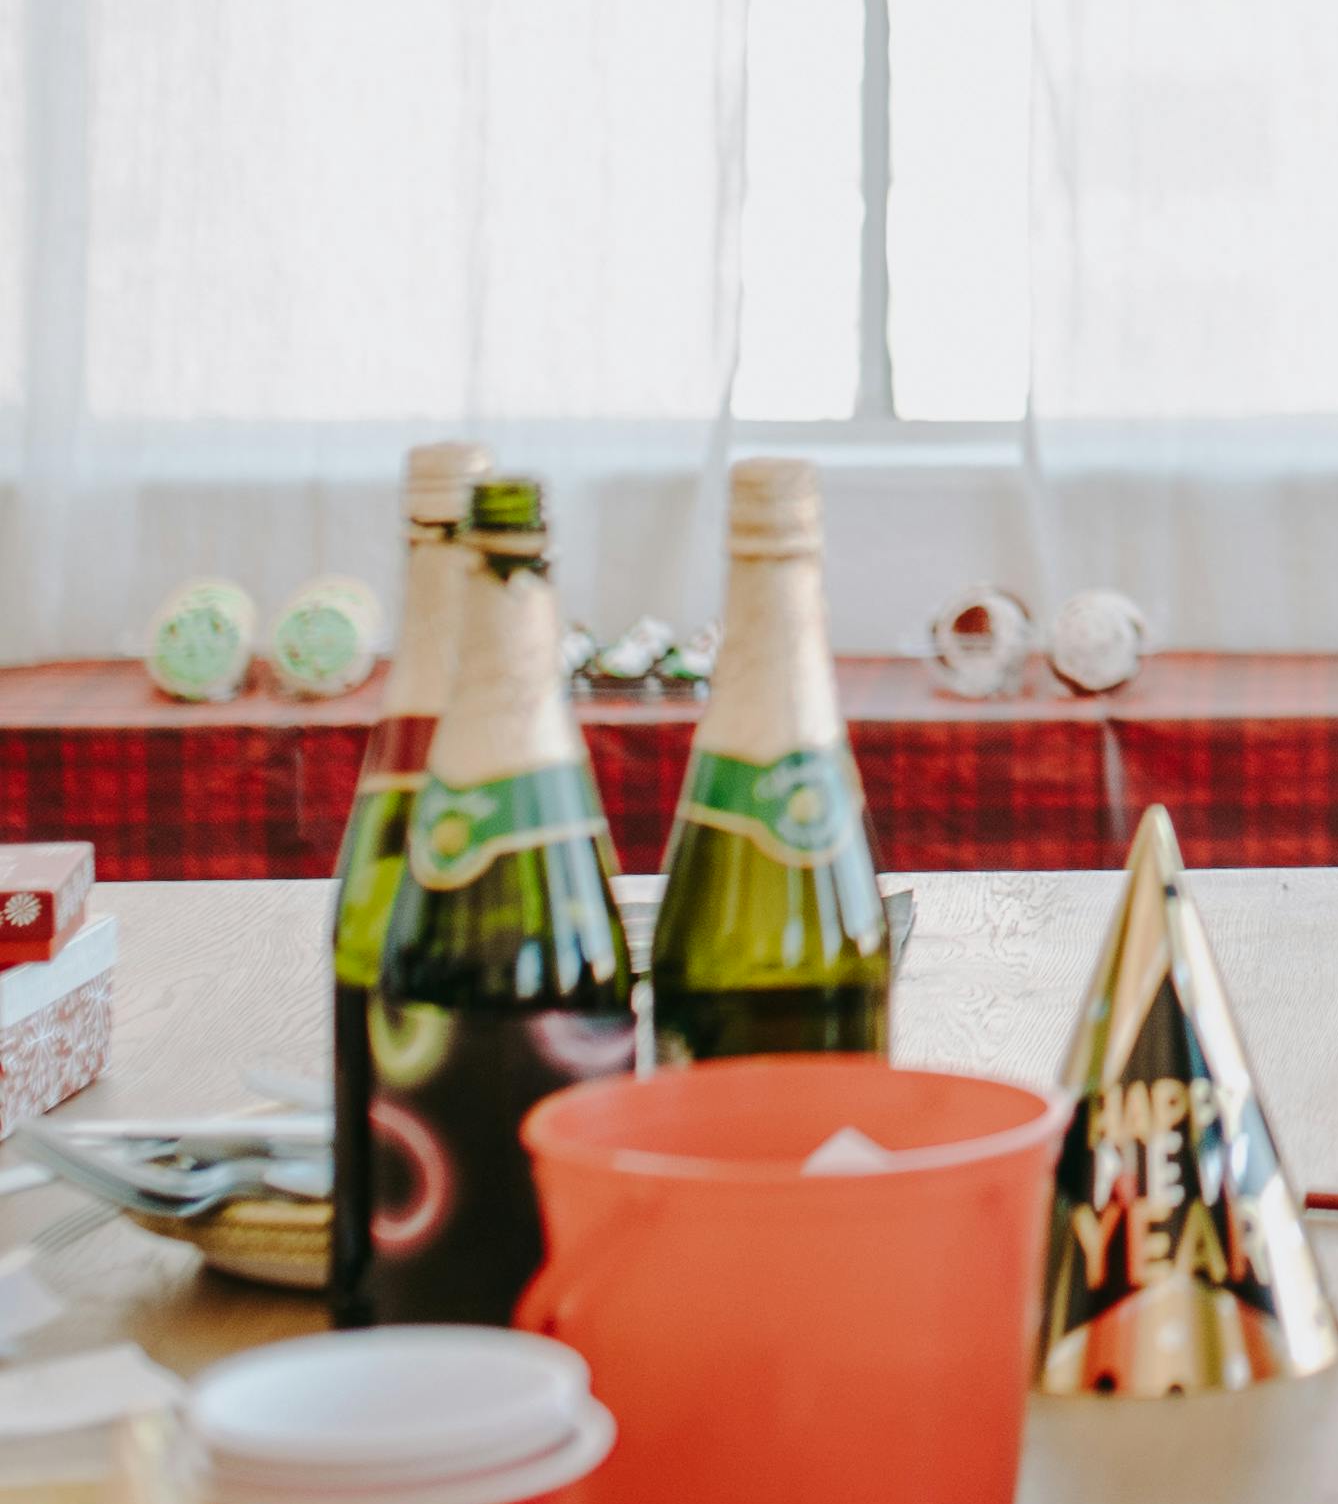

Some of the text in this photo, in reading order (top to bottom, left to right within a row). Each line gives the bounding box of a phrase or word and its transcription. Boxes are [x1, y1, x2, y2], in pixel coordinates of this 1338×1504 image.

[1087, 1076, 1247, 1147] HAPPY
[1094, 1130, 1250, 1212] NEW
[1072, 1199, 1274, 1290] YEAR
